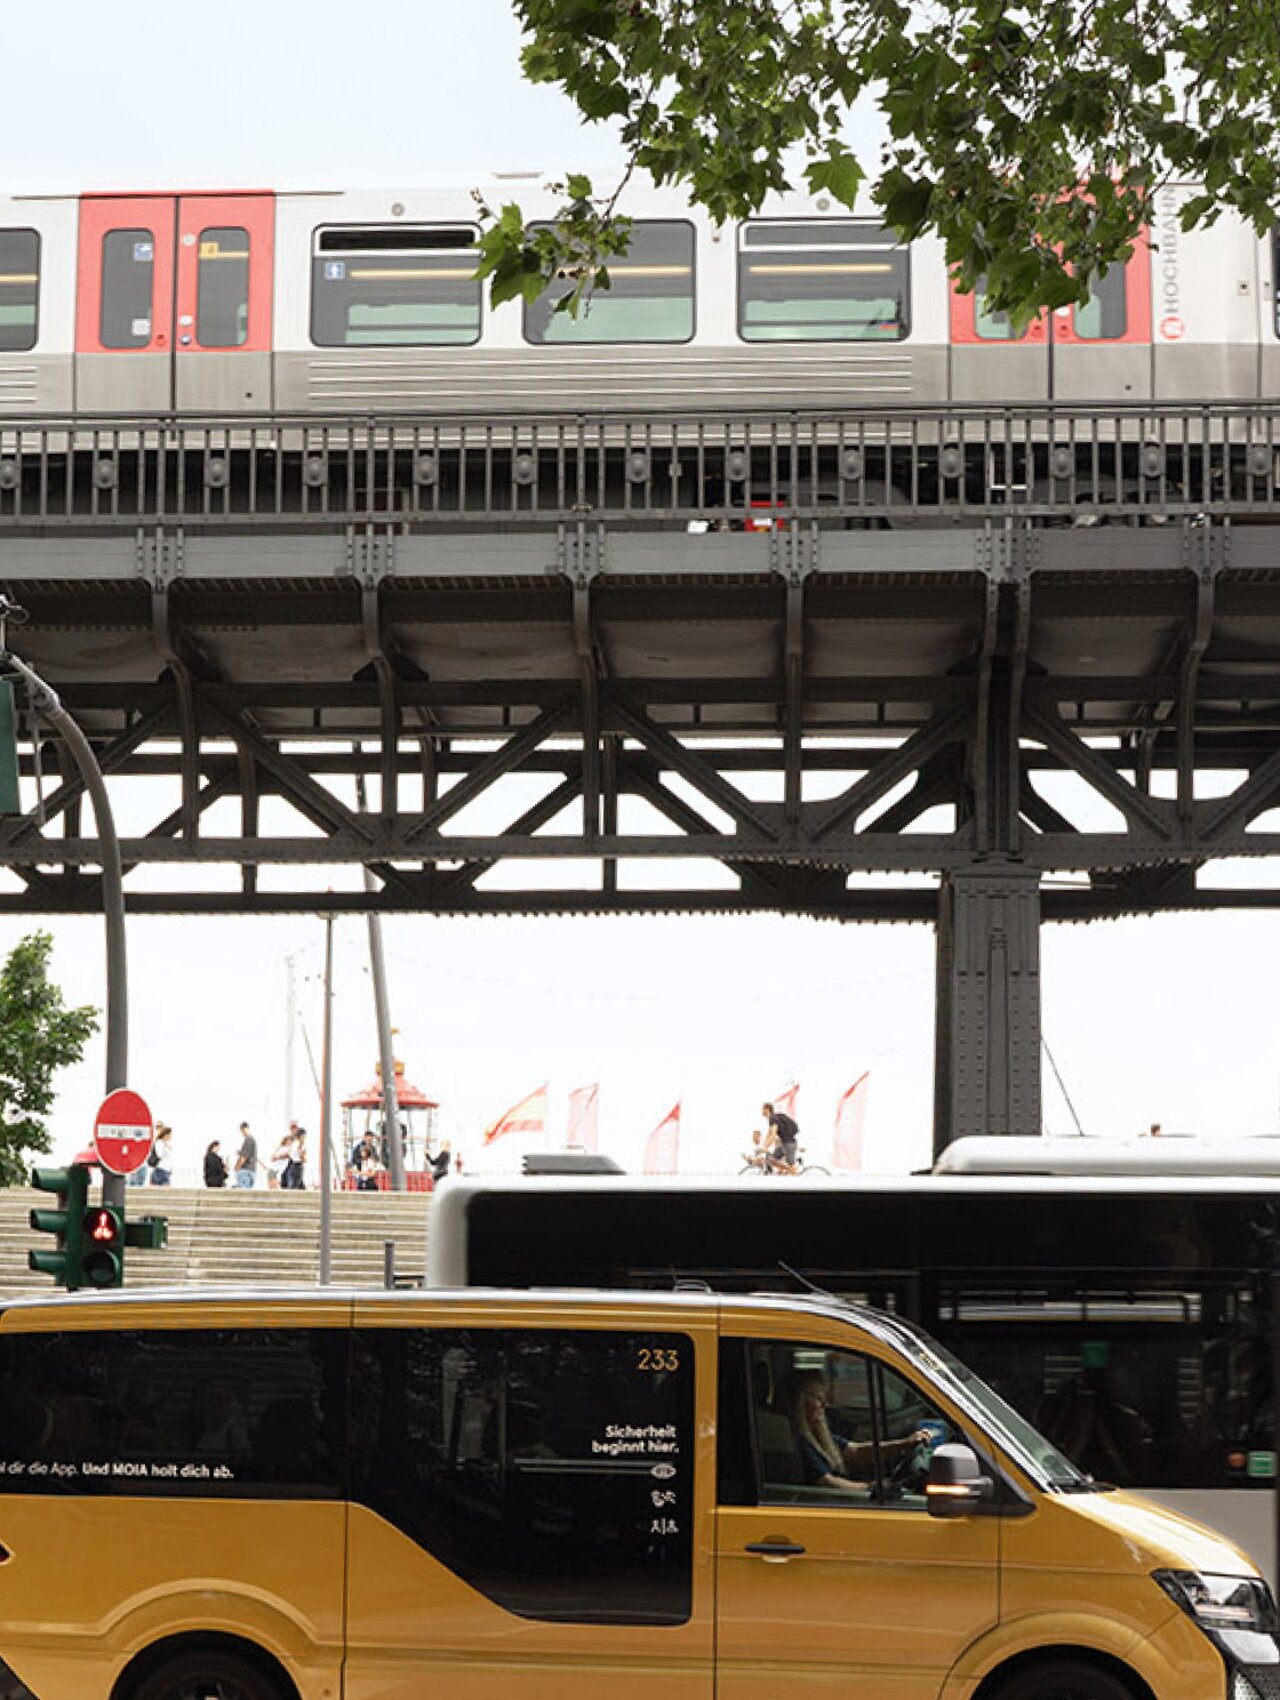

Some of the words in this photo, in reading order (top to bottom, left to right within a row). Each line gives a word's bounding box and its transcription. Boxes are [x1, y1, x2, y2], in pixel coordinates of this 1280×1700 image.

[1162, 187, 1179, 313] HOCHBAHN
[638, 1349, 679, 1371] 233
[605, 1424, 676, 1438] Sicherheit
[592, 1440, 645, 1456] beginnt
[647, 1440, 679, 1453] hier.
[8, 1461, 26, 1475] dir
[28, 1461, 48, 1475] die
[50, 1462, 78, 1478] App.
[82, 1462, 109, 1476] Und
[112, 1463, 148, 1476] MOIA
[151, 1463, 177, 1477] holt
[180, 1463, 210, 1478] dich
[213, 1464, 234, 1478] ab.
